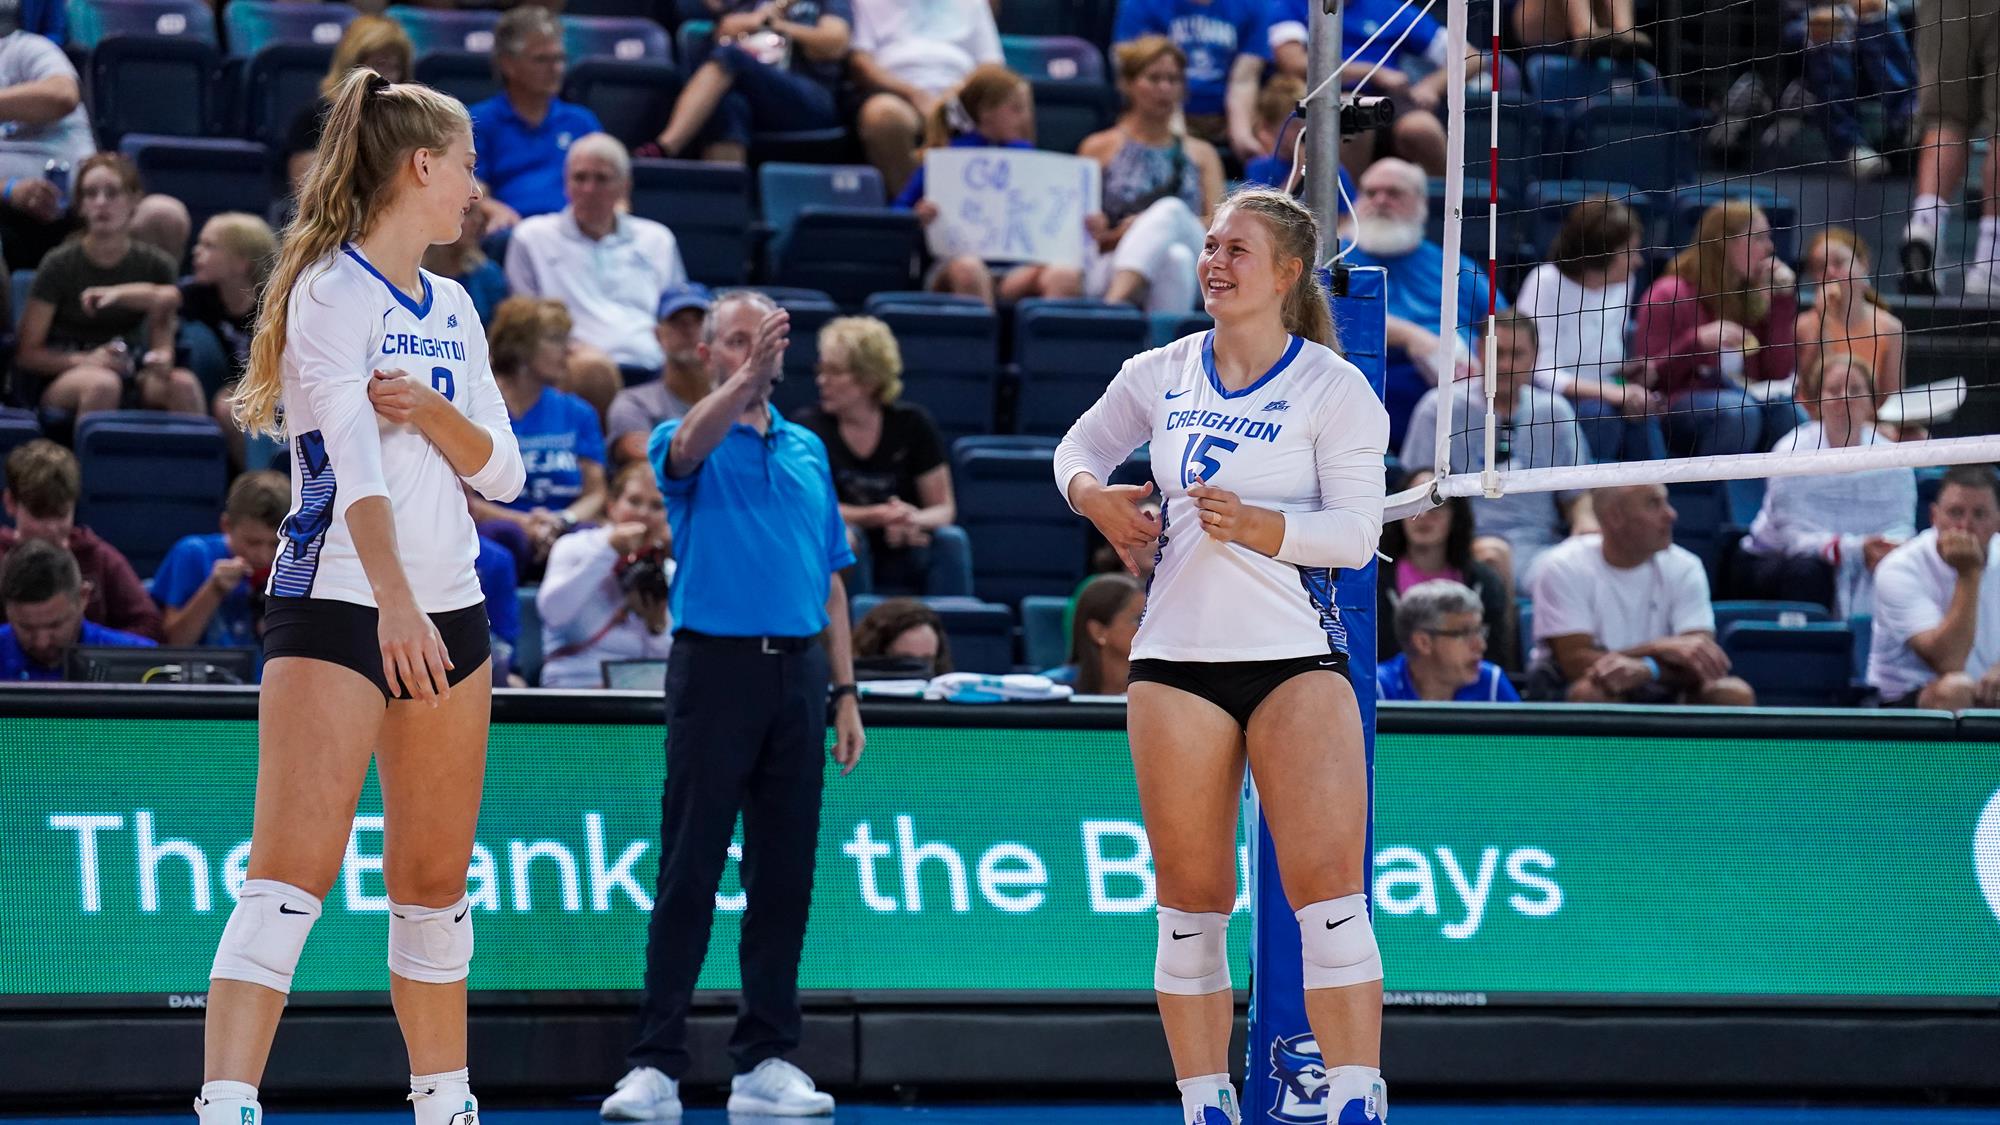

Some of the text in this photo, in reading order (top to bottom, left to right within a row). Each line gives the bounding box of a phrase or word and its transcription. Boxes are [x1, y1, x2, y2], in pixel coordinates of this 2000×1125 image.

[1166, 409, 1282, 443] CREIGHTON
[1180, 432, 1239, 490] 15
[842, 814, 1048, 913] the
[1383, 991, 1487, 1006] DAKTRONICS
